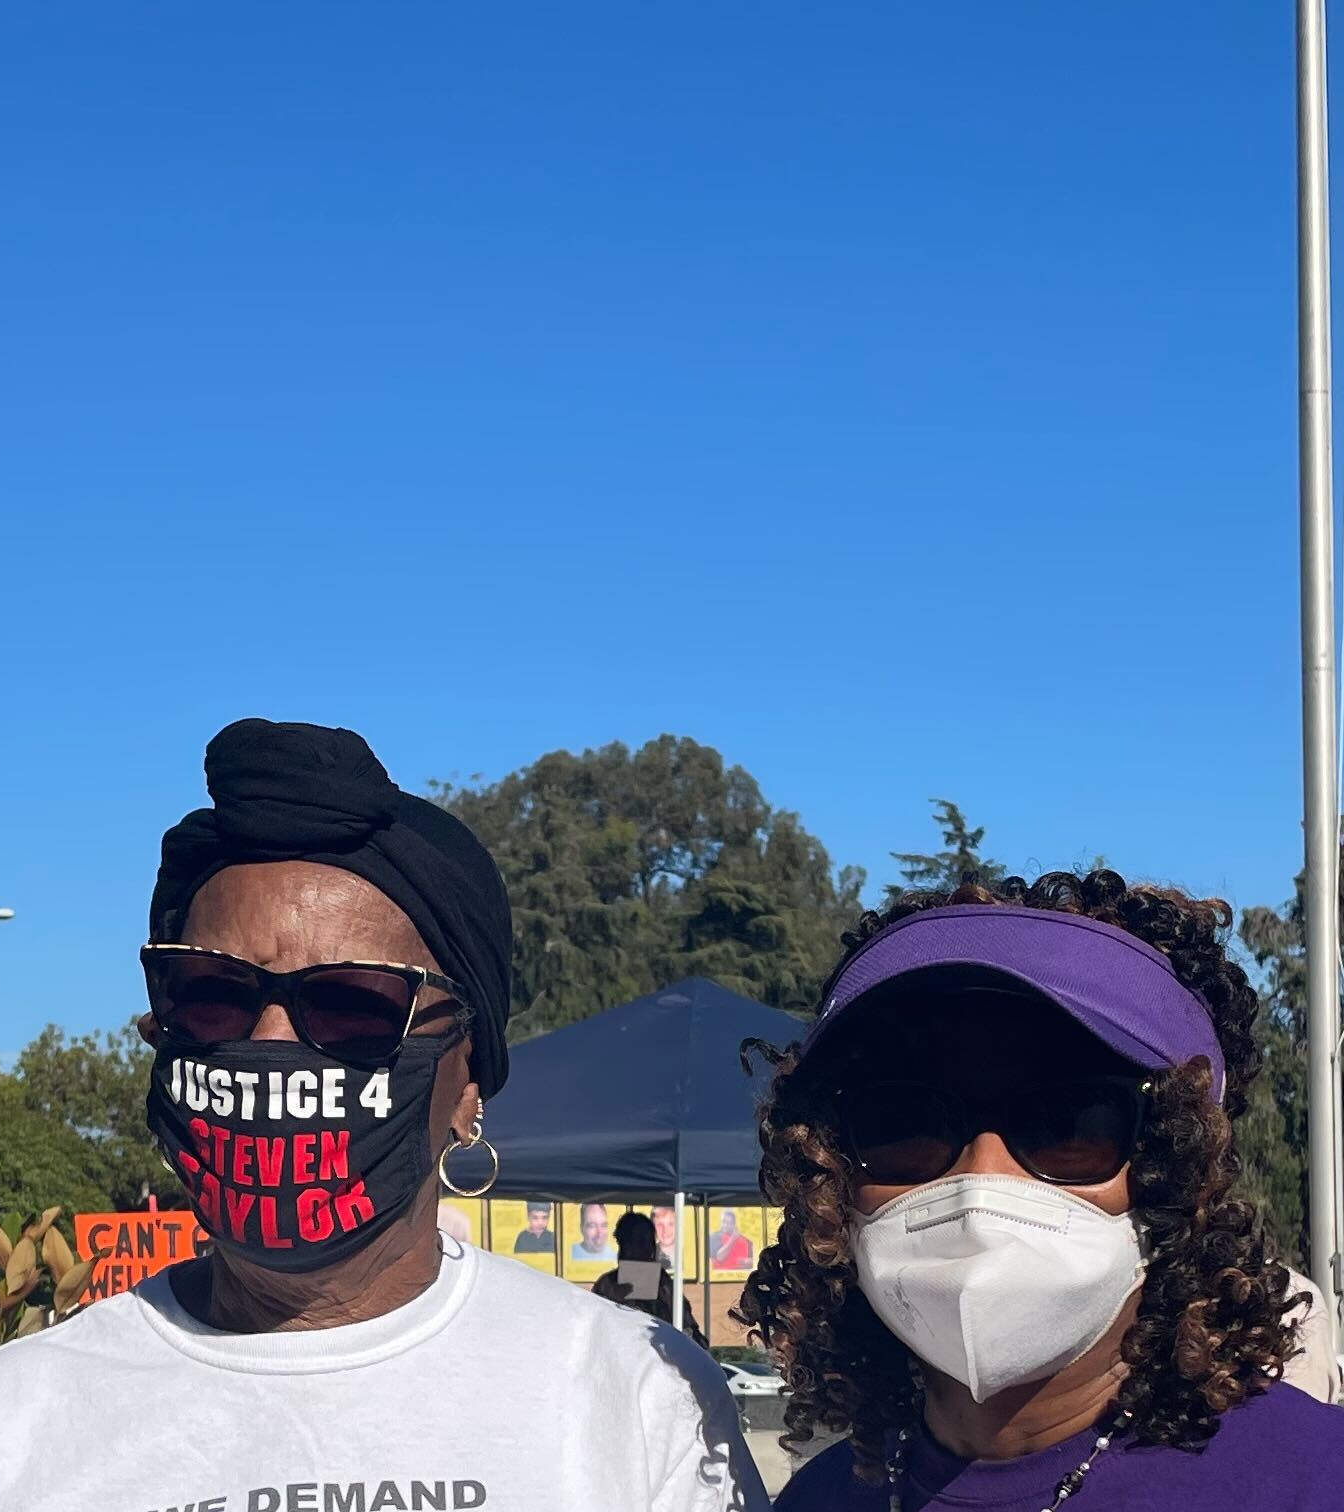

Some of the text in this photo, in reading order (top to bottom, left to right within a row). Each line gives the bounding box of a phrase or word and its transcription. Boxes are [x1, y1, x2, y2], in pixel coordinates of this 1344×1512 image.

[170, 1057, 392, 1121] JUSTICE 4
[189, 1117, 350, 1187] STEVEN
[87, 1218, 182, 1259] CAN'T
